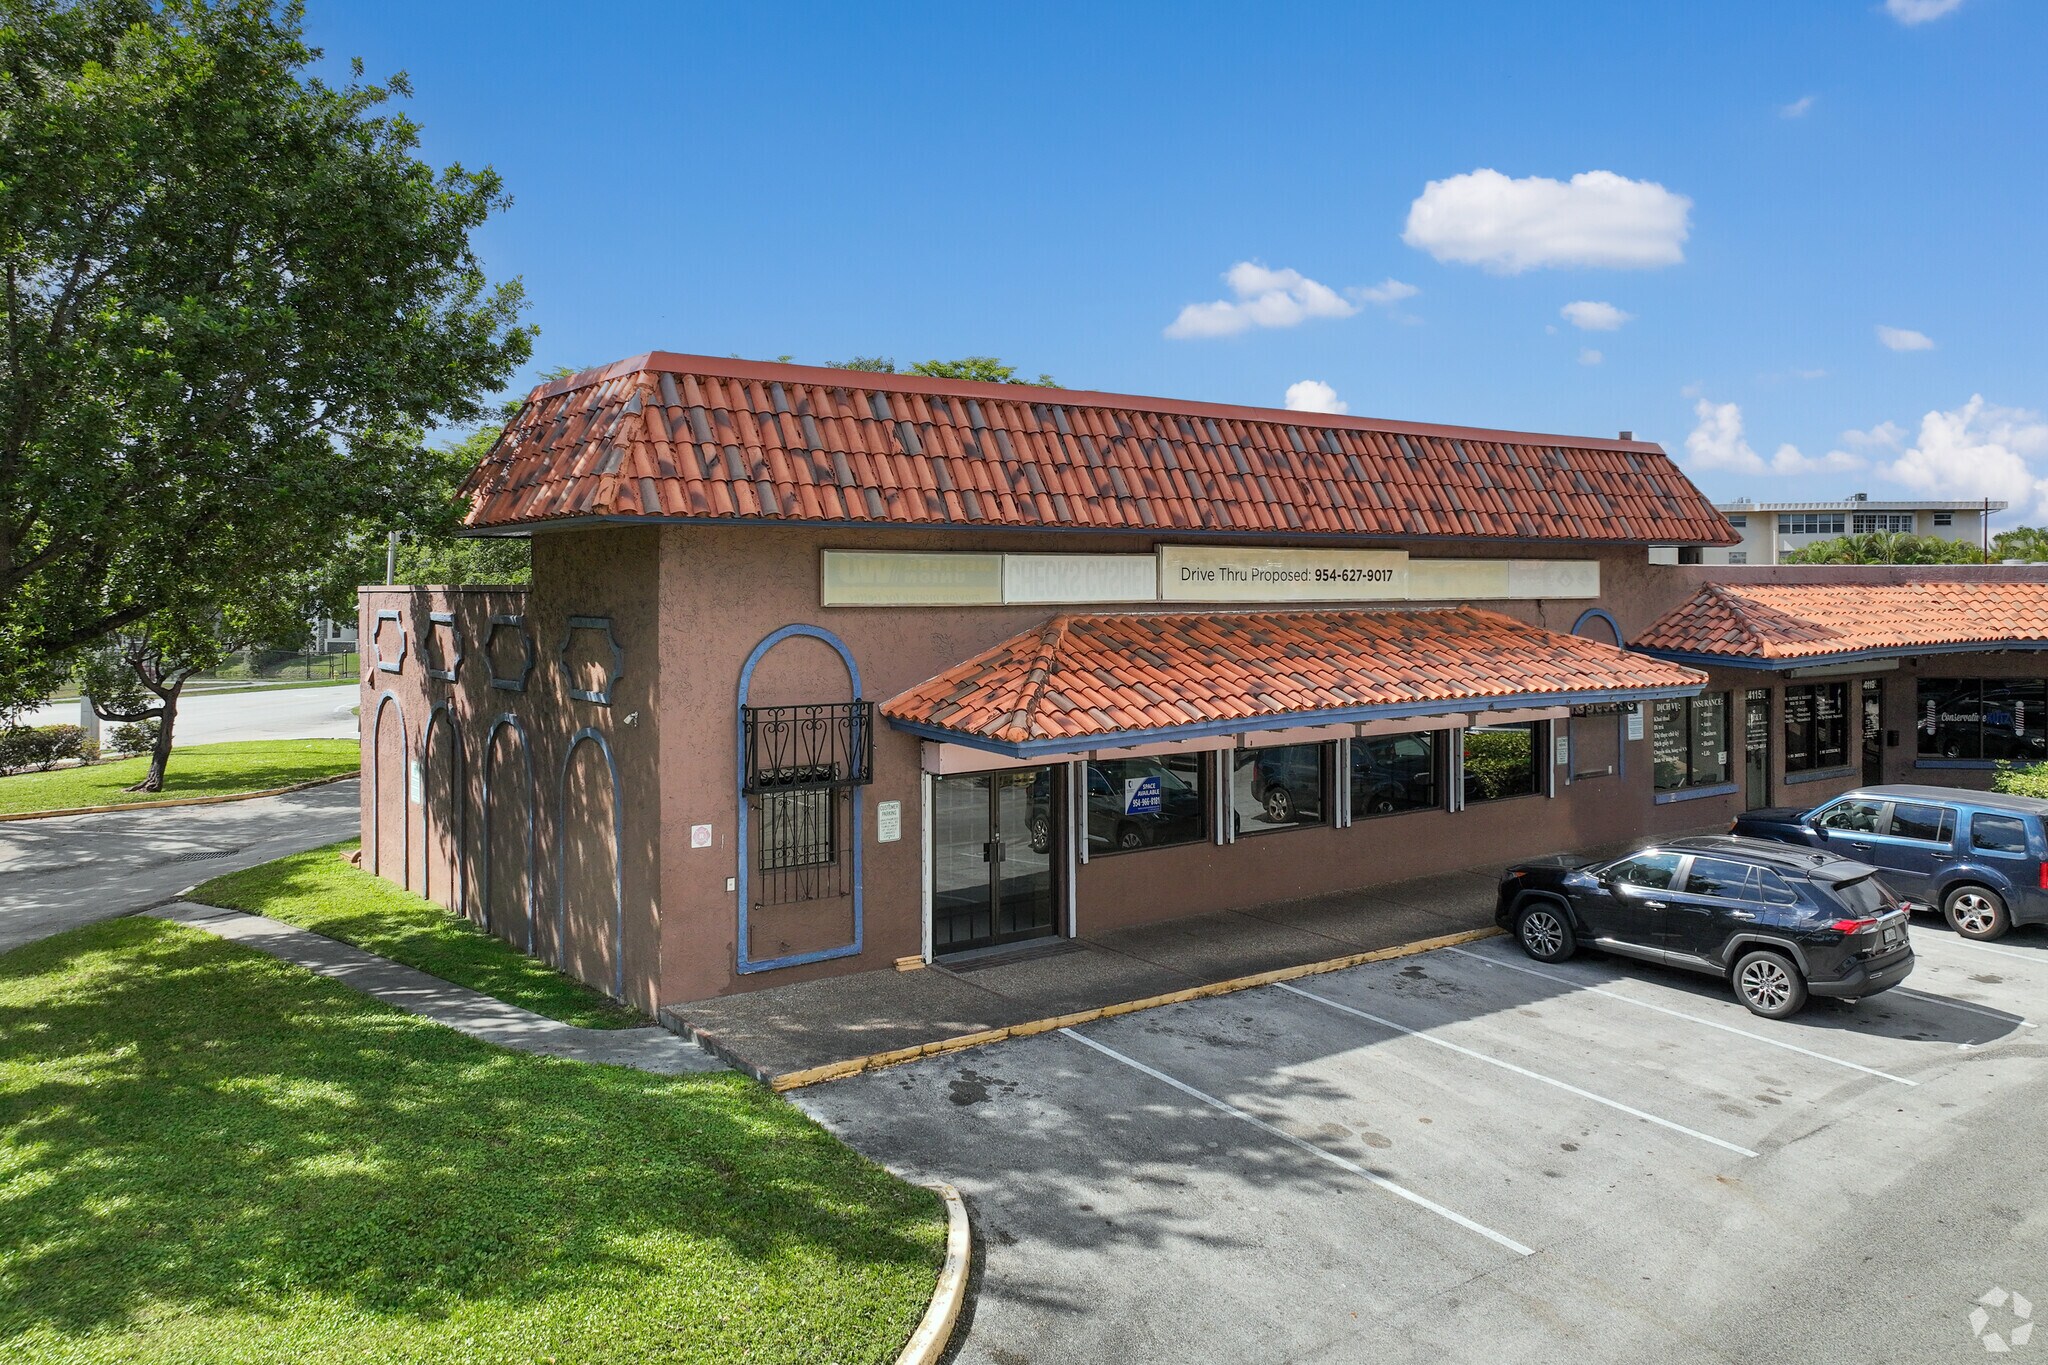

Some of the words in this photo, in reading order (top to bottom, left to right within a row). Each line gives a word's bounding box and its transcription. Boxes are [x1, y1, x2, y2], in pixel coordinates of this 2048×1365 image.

[1181, 567, 1215, 582] Drive
[1219, 567, 1247, 582] Thru
[1251, 568, 1312, 584] Proposed:
[1314, 568, 1393, 582] 954-627-9017
[1748, 690, 1762, 699] 4115
[1137, 789, 1160, 797] AVAILABLE
